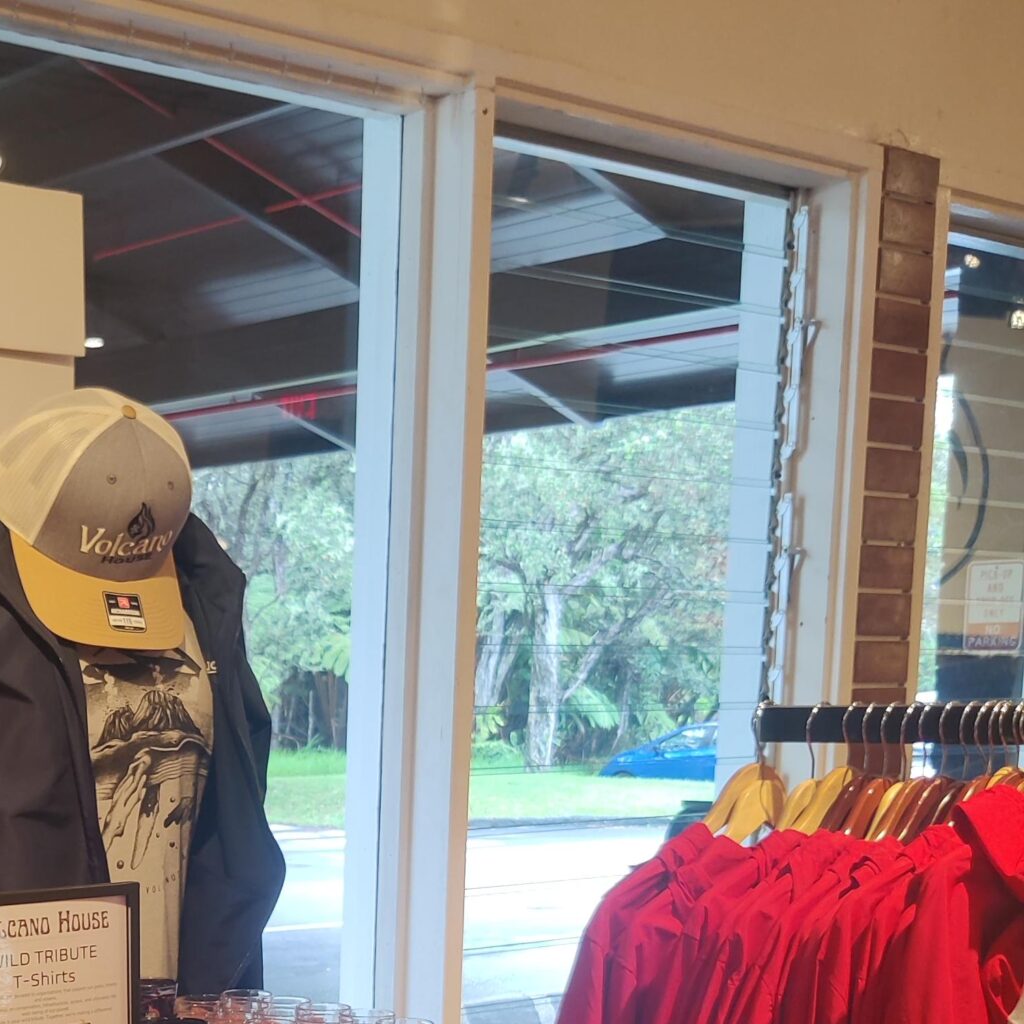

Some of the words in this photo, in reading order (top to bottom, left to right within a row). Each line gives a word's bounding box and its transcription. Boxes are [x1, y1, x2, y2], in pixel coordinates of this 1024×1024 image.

[79, 525, 174, 557] Volcano
[967, 636, 1017, 648] PARKING
[58, 910, 110, 933] HOUSE
[34, 945, 97, 964] TRIBUTE
[14, 971, 76, 989] T-Shirts
